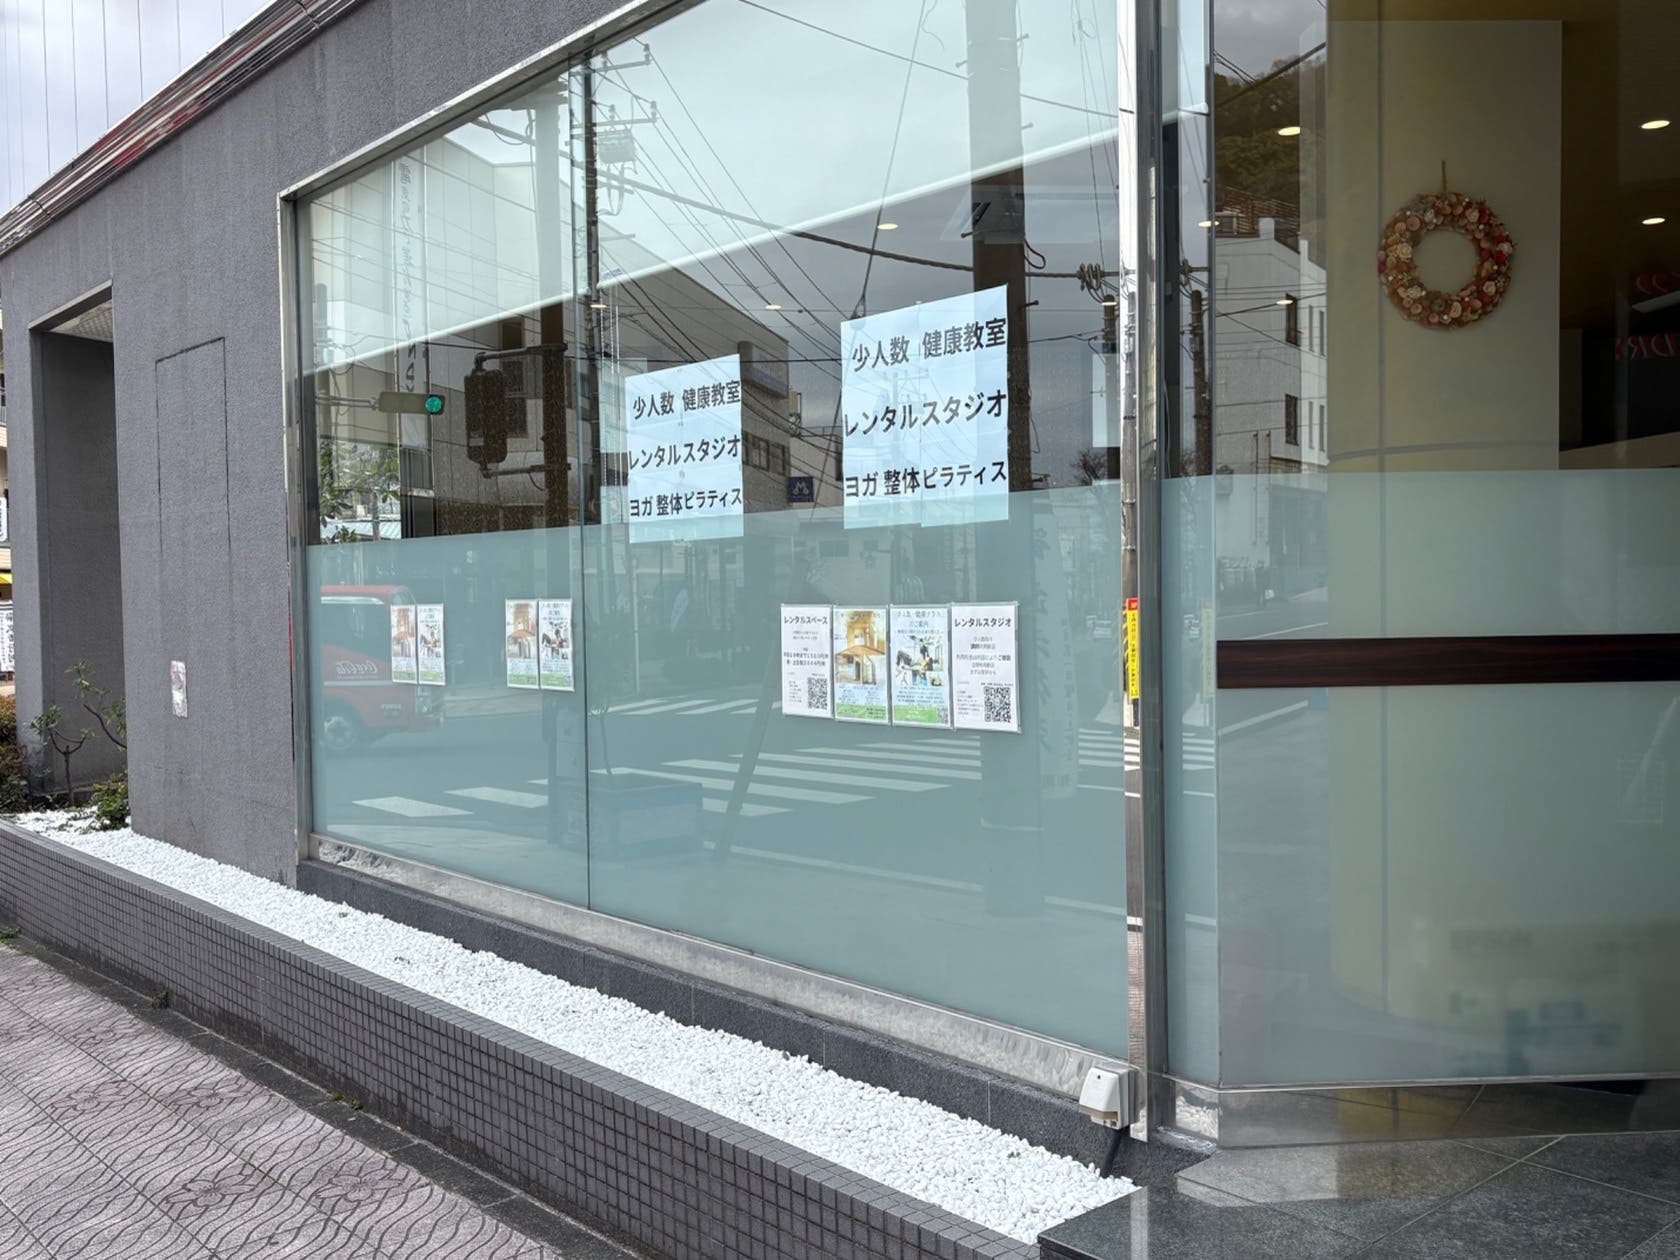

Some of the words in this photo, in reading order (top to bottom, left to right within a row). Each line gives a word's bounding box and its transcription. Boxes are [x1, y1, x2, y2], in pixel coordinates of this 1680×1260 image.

[852, 335, 910, 373] 少人数
[921, 317, 1006, 360] 健康教室
[633, 391, 675, 420] 少人数
[682, 380, 741, 412] 健康教室
[845, 389, 1007, 437] レンタルスタジオ
[628, 434, 741, 470] レンタルスタジオ
[845, 472, 878, 498] ヨガ
[630, 496, 653, 517] ヨガ
[784, 616, 828, 625] レンタルスペース
[954, 617, 1012, 628] レンタルスタジオ
